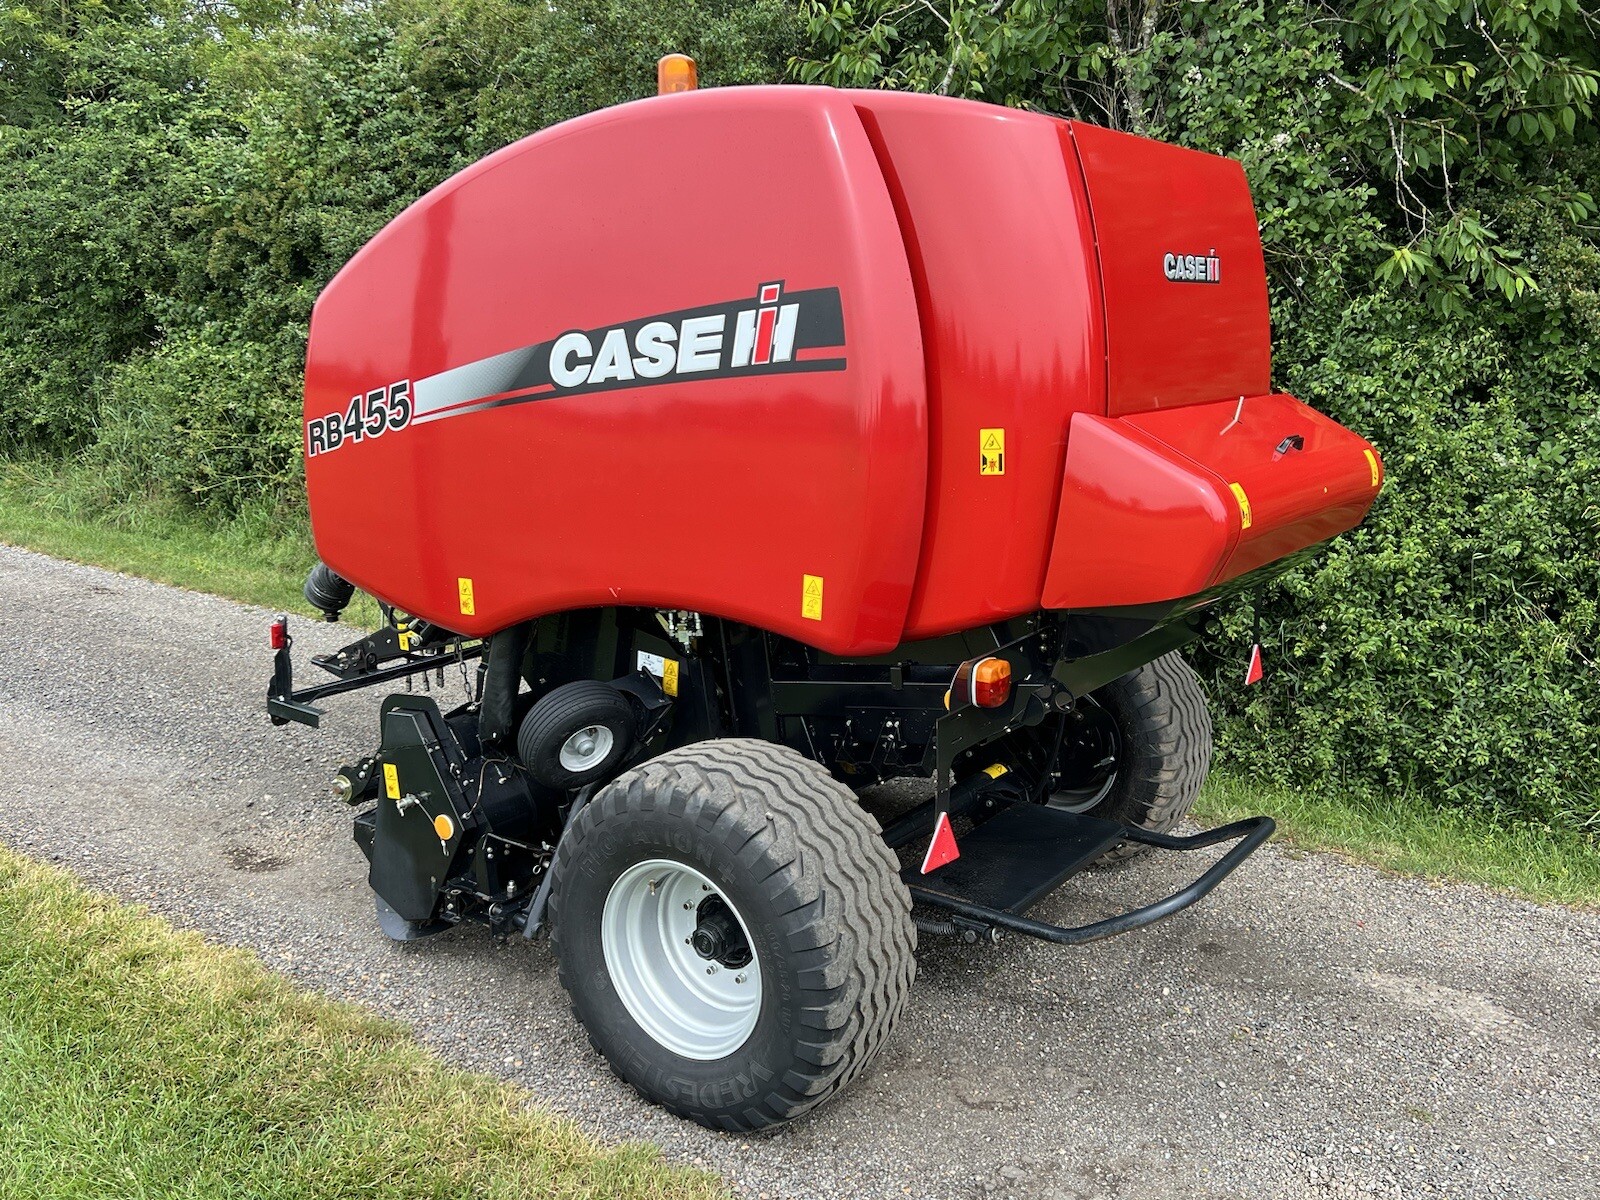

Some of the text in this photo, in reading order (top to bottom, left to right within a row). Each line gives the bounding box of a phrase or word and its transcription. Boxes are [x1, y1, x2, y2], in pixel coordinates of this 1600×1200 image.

[1164, 253, 1206, 280] CASE
[549, 314, 726, 388] CASE
[308, 380, 411, 456] RB455
